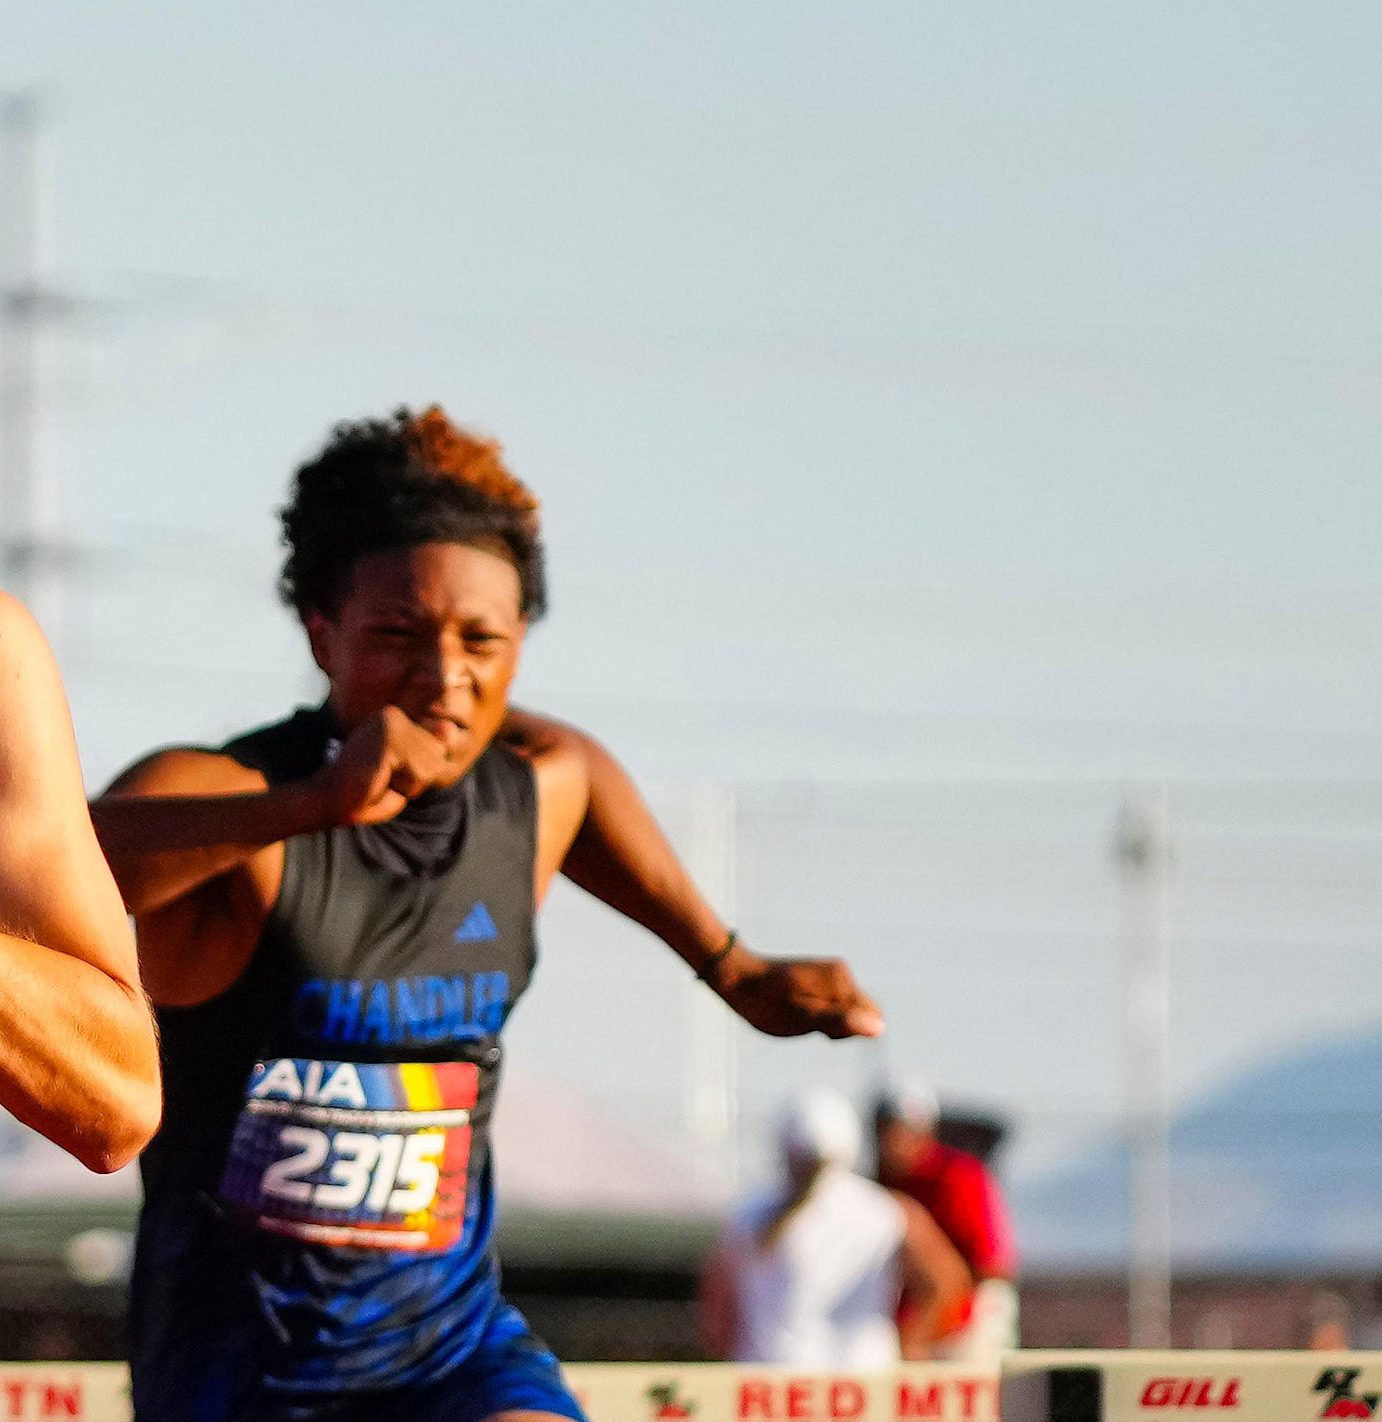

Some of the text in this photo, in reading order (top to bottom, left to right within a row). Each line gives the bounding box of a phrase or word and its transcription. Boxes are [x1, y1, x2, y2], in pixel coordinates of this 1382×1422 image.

[251, 1059, 367, 1108] AIA
[261, 1126, 446, 1213] 2315
[738, 1379, 1000, 1422] RED MT
[1140, 1377, 1241, 1409] GILL
